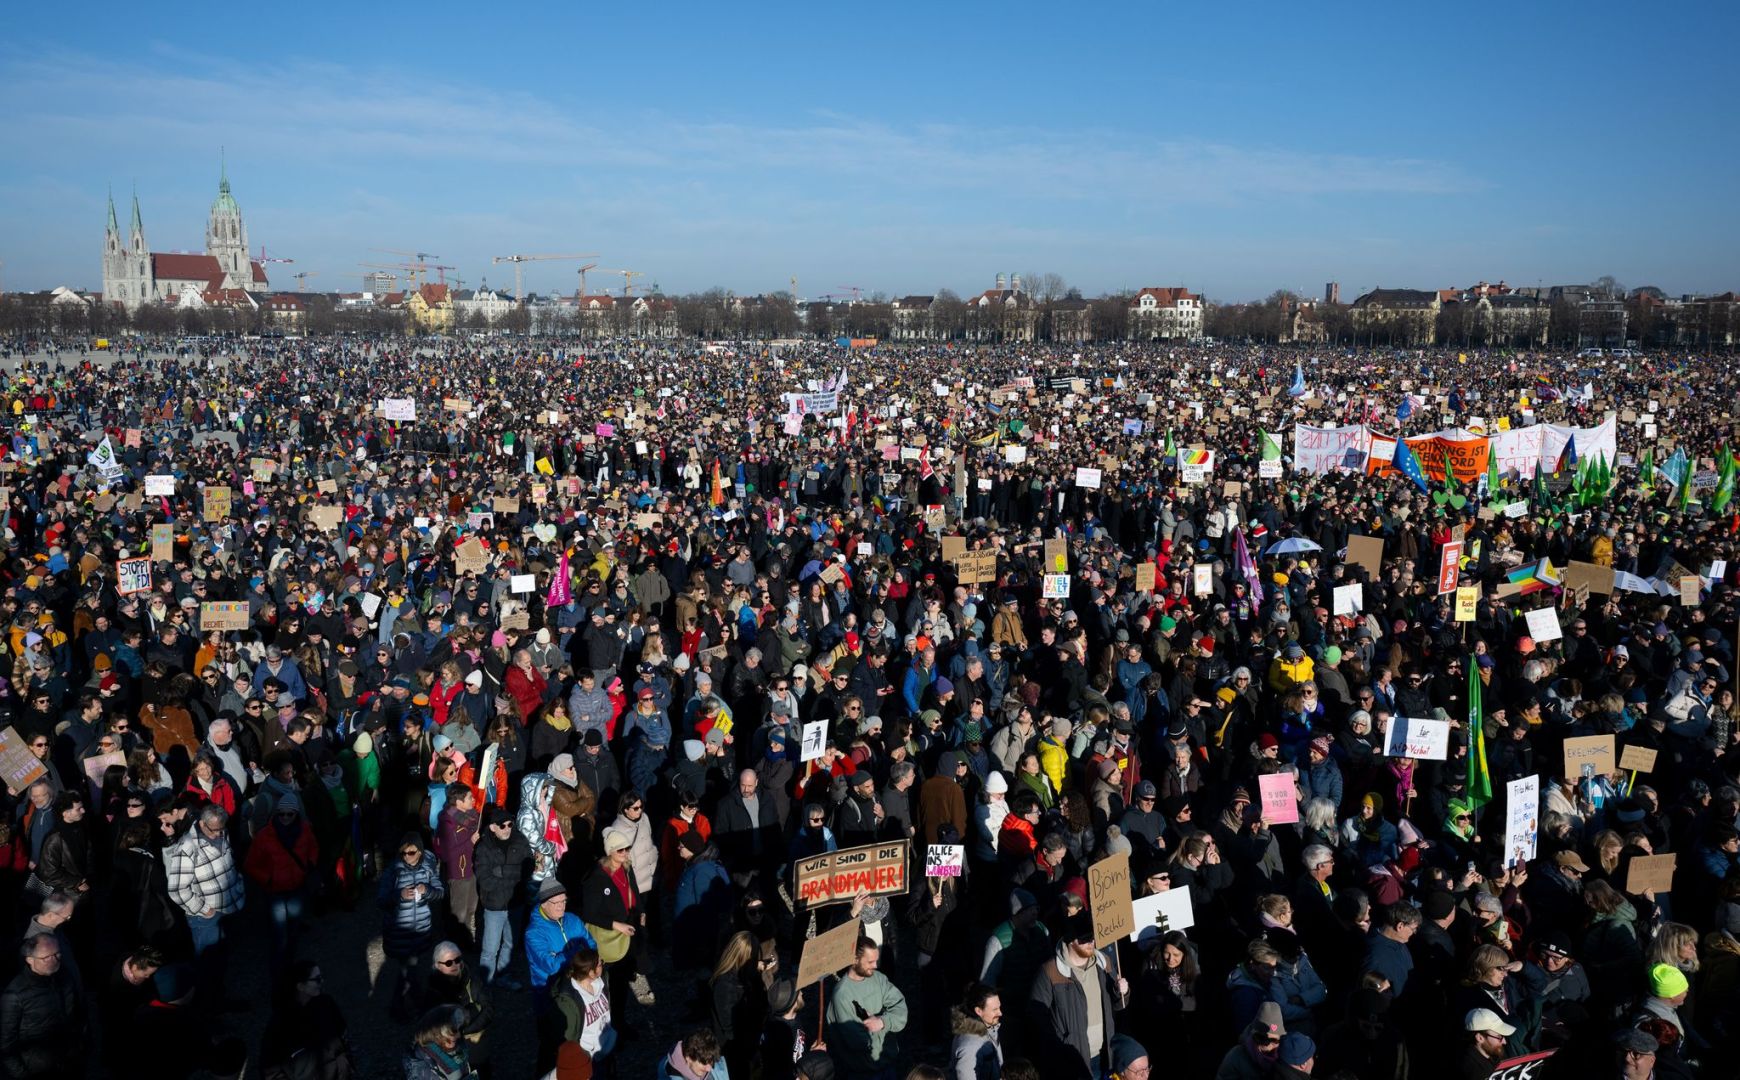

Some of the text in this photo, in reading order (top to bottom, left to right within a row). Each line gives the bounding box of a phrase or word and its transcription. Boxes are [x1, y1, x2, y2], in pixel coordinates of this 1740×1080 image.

[1471, 445, 1485, 455] IST
[120, 560, 148, 576] STOPPT
[130, 574, 150, 590] AFD!
[1045, 576, 1067, 585] VIEL
[1045, 584, 1068, 592] FALT
[928, 845, 953, 856] ALICE
[805, 848, 898, 871] WIR SIND DIE
[927, 855, 942, 866] INS
[800, 863, 904, 901] BRANDMAUER!
